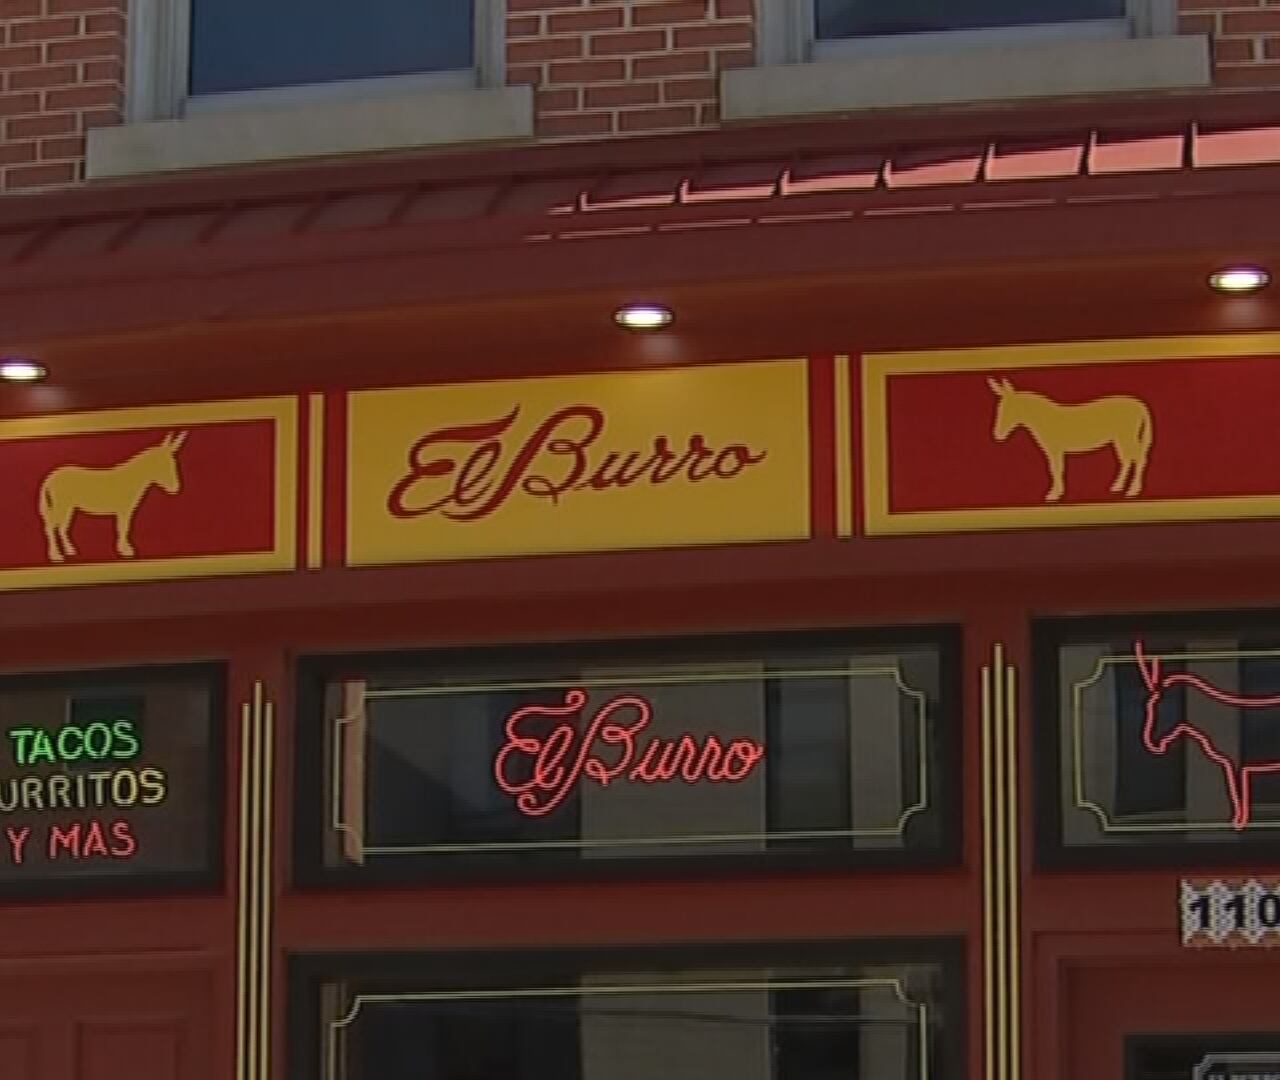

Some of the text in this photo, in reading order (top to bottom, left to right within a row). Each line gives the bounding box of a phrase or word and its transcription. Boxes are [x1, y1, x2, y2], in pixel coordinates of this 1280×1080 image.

[386, 401, 767, 522] El Burro
[9, 720, 139, 764] TACOS
[494, 690, 764, 816] El Burro
[6, 820, 137, 864] Y MAS
